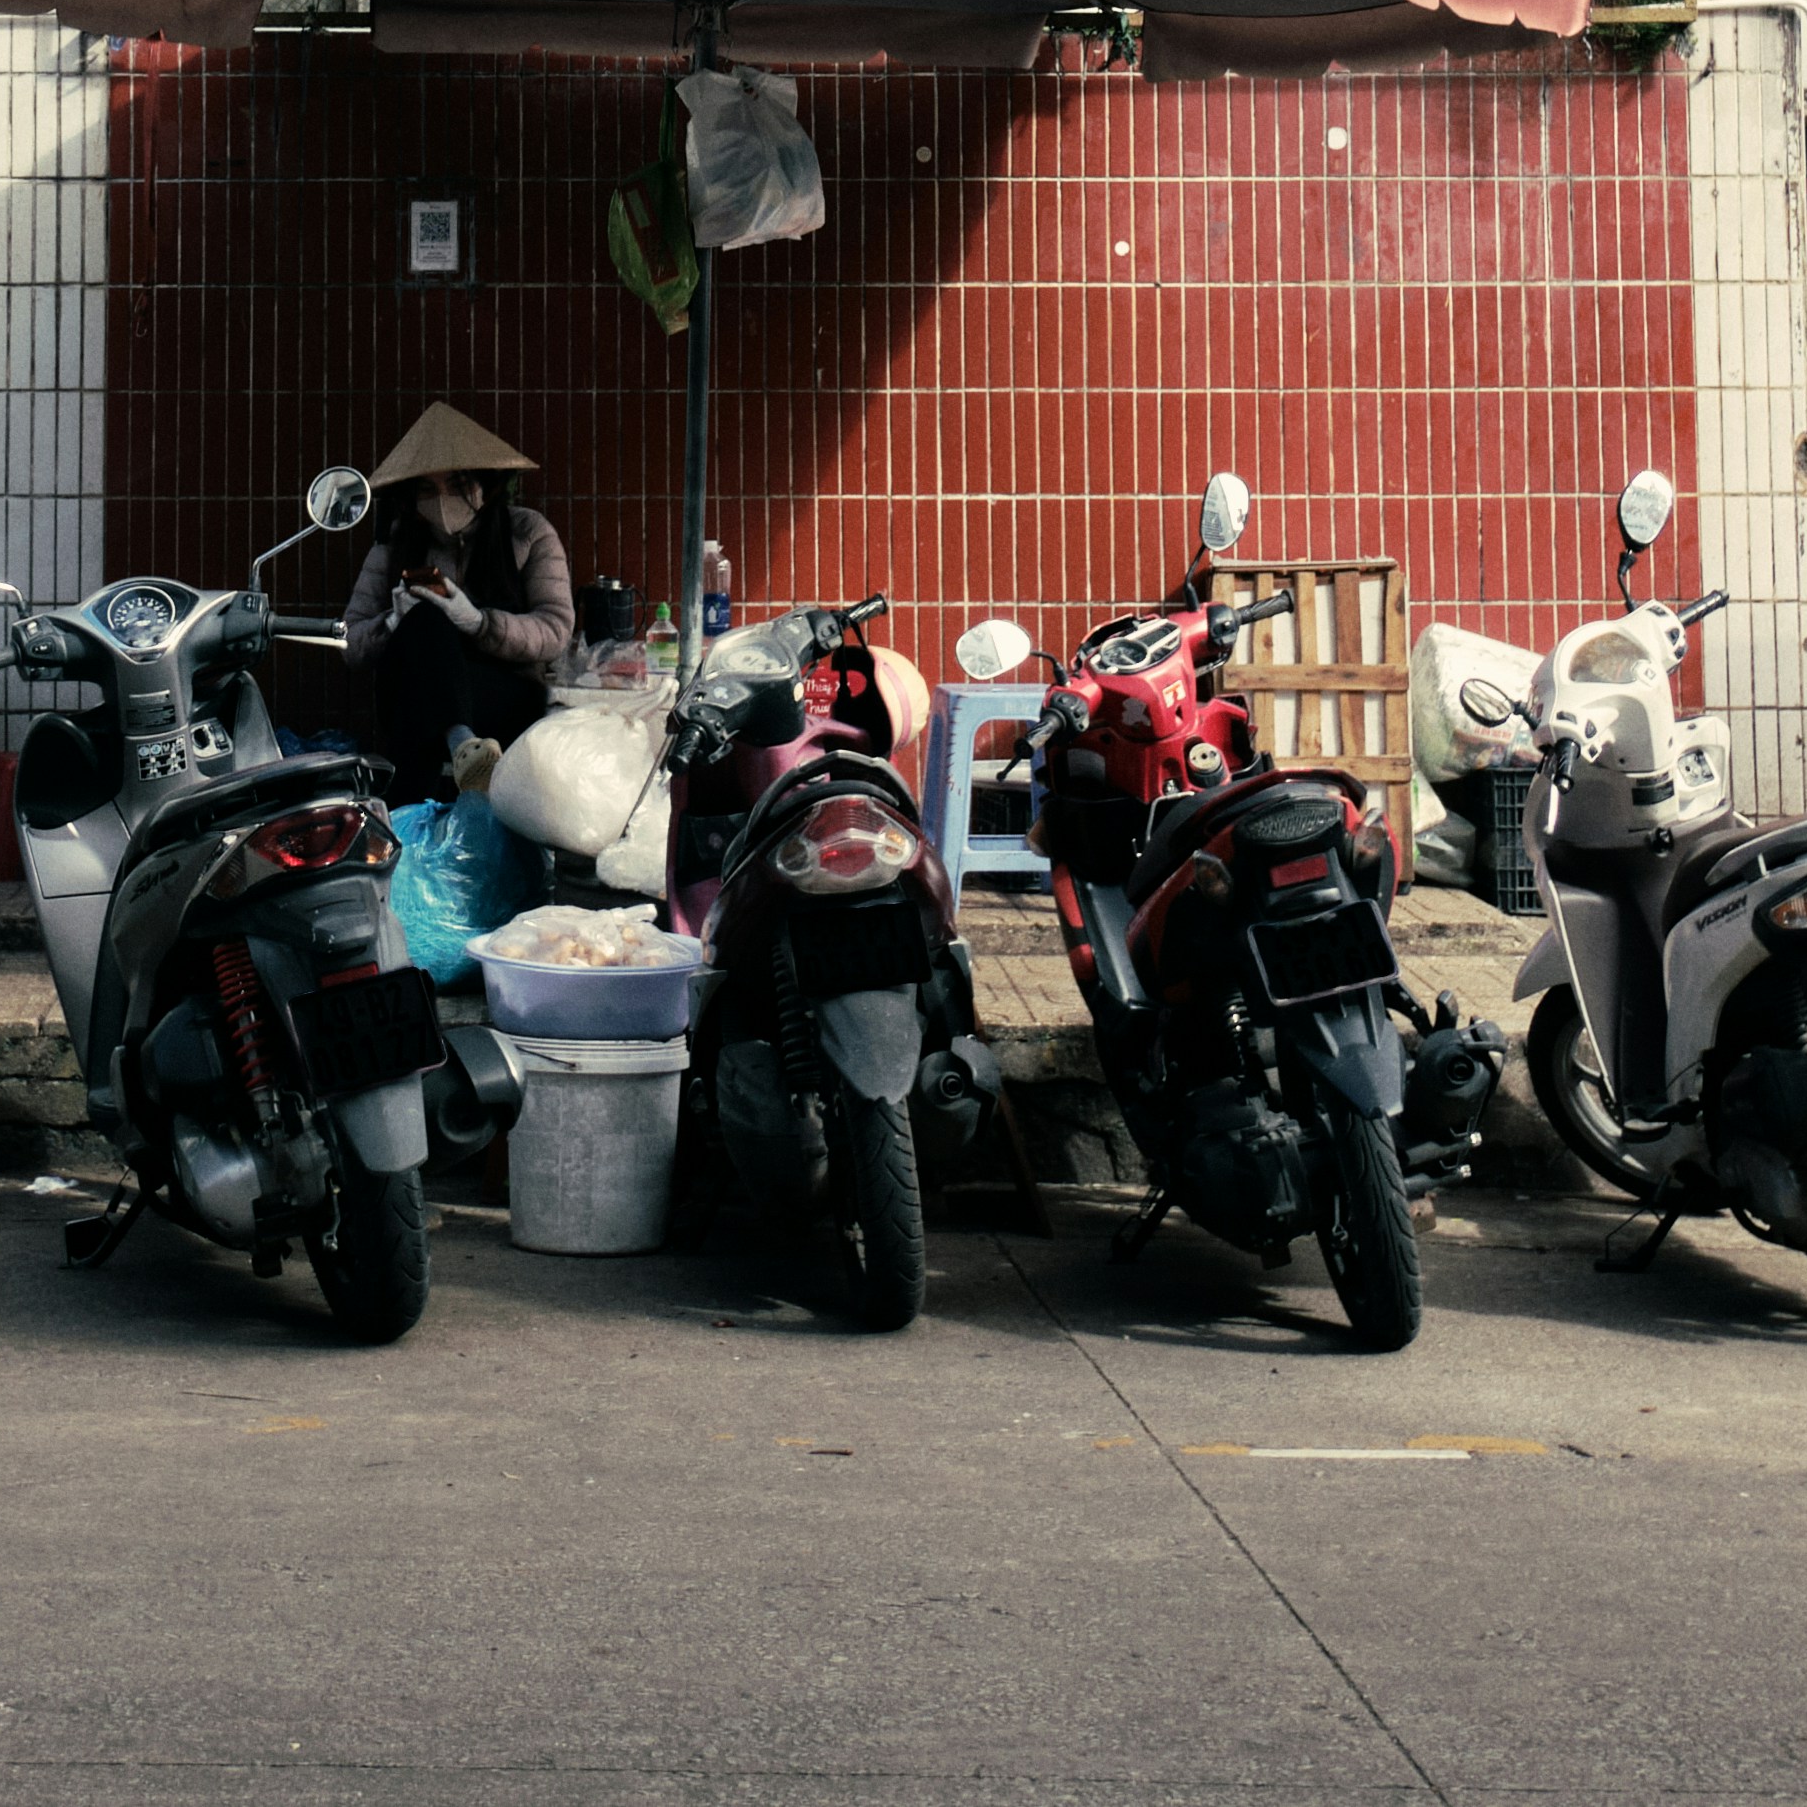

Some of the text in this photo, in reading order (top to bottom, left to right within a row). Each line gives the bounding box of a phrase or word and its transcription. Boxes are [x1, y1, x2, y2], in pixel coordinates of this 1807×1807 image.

[1272, 939, 1391, 995] 158.60
[315, 980, 411, 1037] 49-B2
[310, 1021, 427, 1086] 081.27
